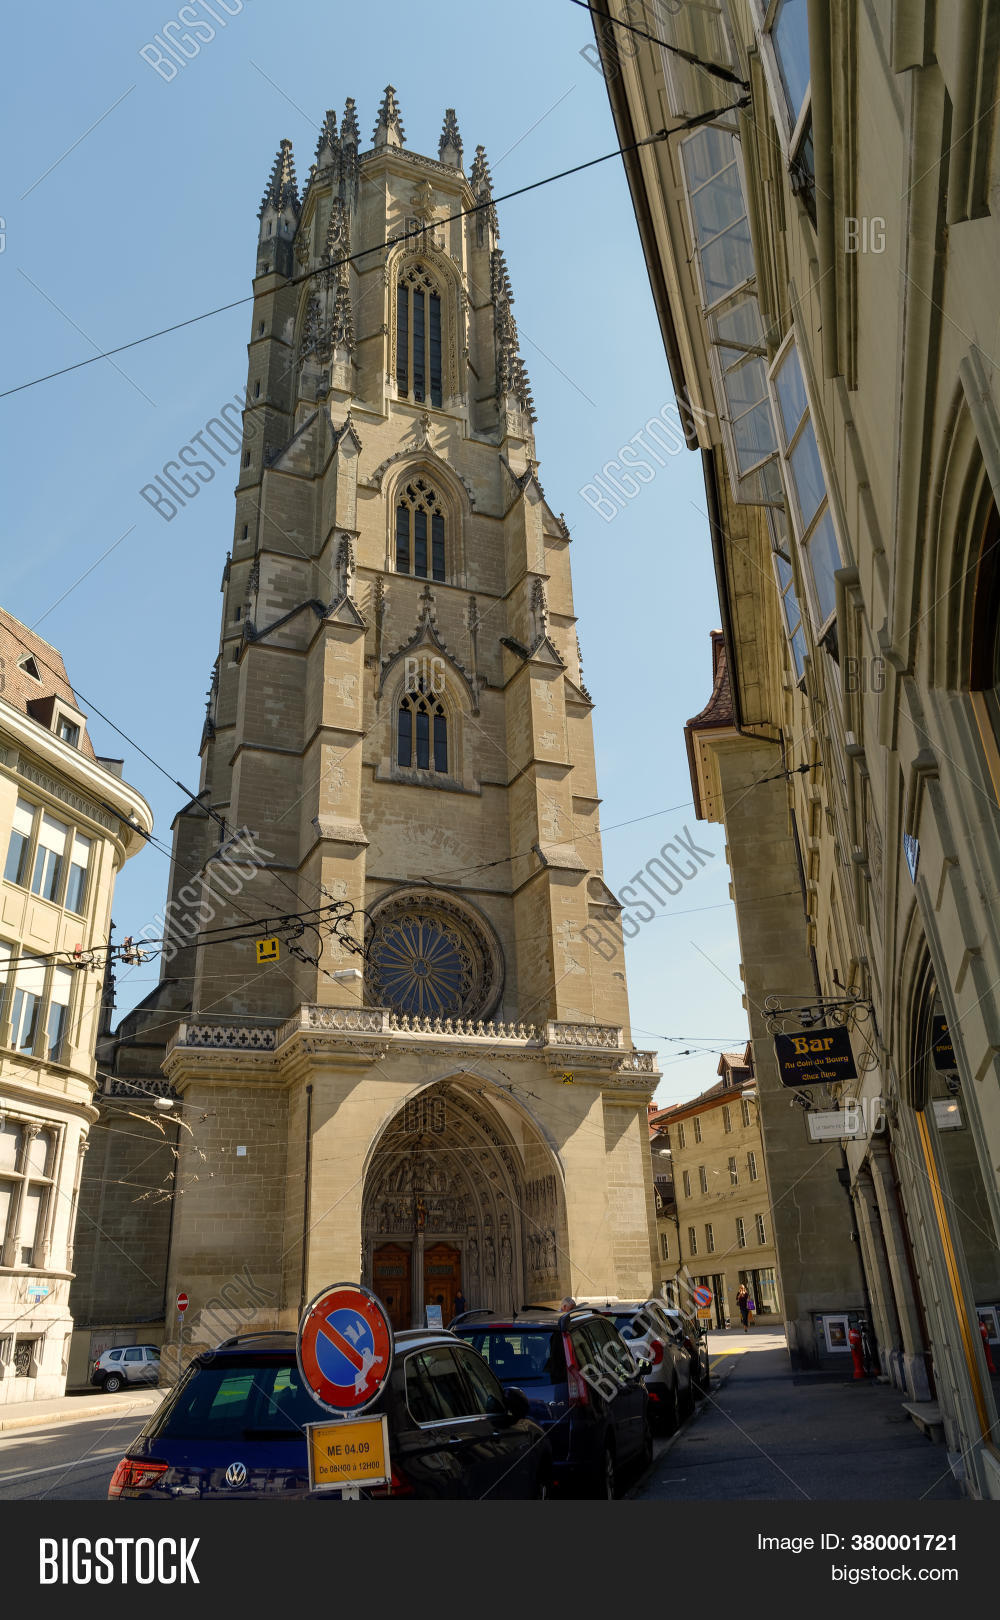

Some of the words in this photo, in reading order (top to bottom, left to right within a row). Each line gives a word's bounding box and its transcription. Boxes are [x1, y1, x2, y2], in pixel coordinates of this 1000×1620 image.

[791, 1037, 834, 1055] Bar
[796, 1060, 813, 1068] Coin
[825, 1056, 849, 1064] Bourg
[327, 1444, 342, 1457] ME
[344, 1442, 370, 1455] 04.09
[319, 1466, 328, 1474] De
[329, 1464, 351, 1473] 08H00
[359, 1461, 380, 1470] 12H00
